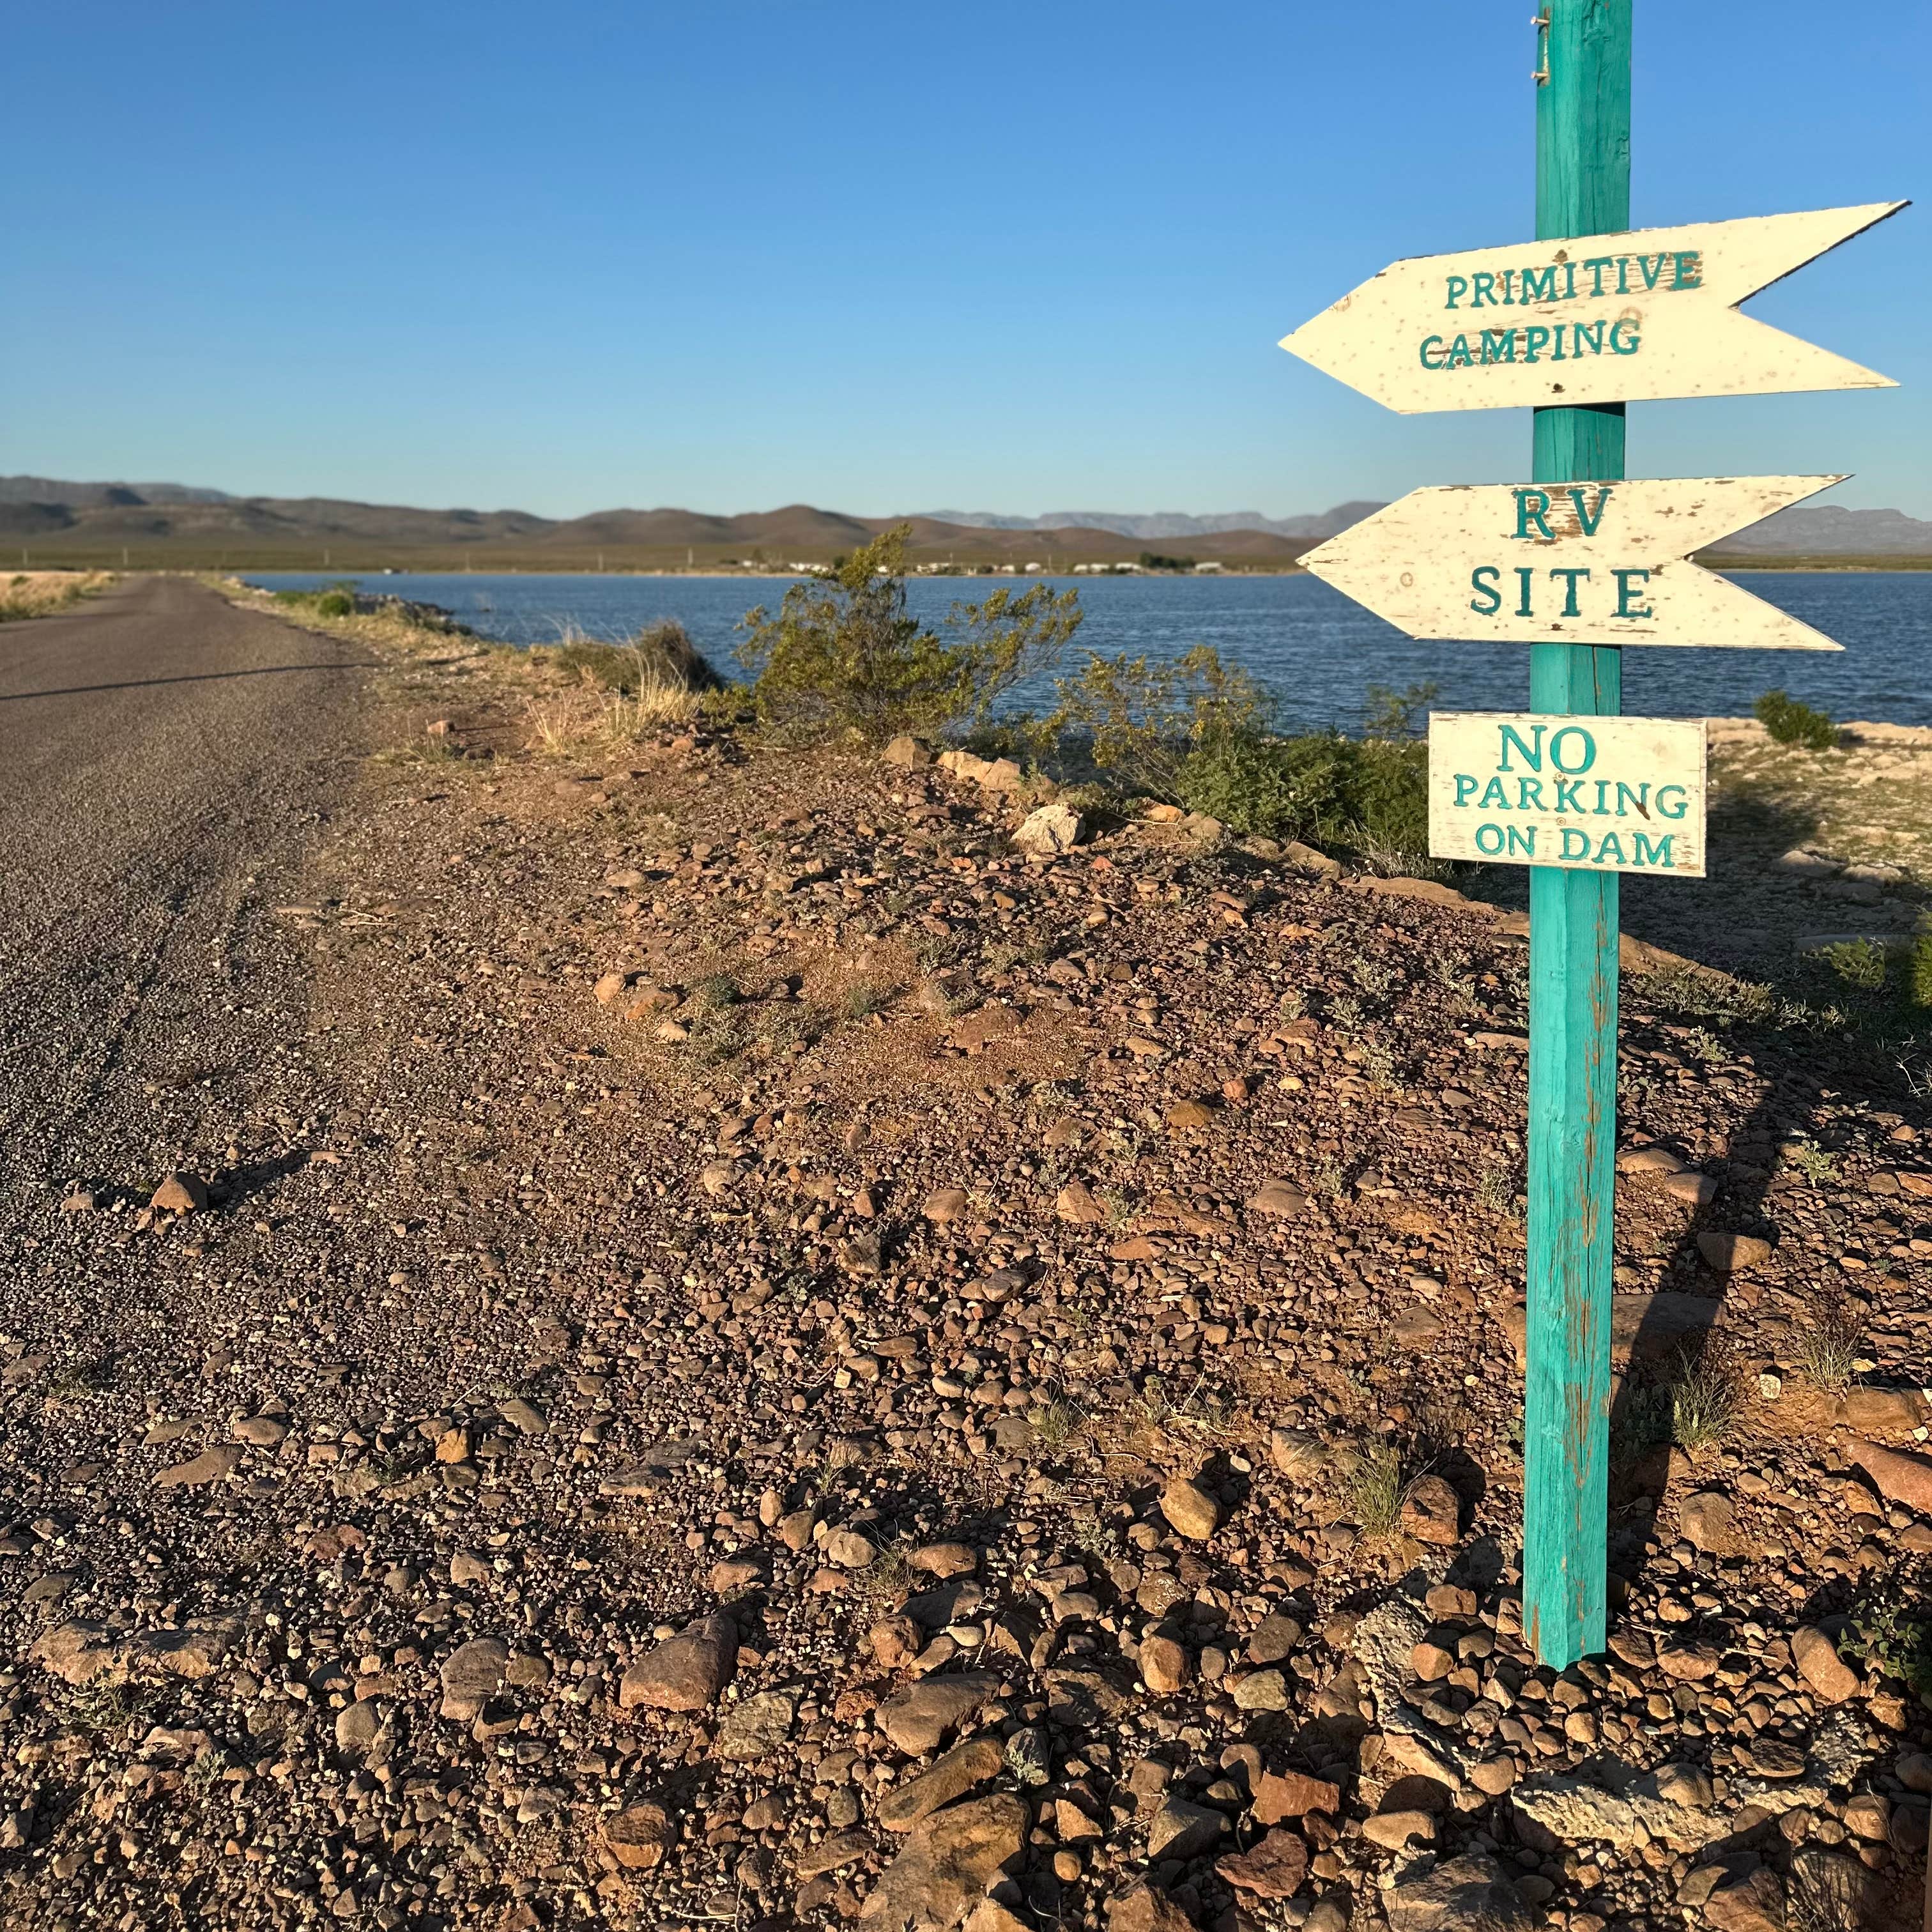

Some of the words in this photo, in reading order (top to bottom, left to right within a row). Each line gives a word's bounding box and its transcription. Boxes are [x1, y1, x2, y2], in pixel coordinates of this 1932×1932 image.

[1445, 250, 1703, 309] PRIMITIVE
[1420, 318, 1641, 370] CAMPING
[1510, 487, 1614, 539] RV
[1470, 566, 1652, 618] SITE
[1497, 724, 1597, 774] NO
[1453, 774, 1689, 820] PARKING
[1476, 823, 1537, 856] ON
[1558, 828, 1675, 868] DAM
